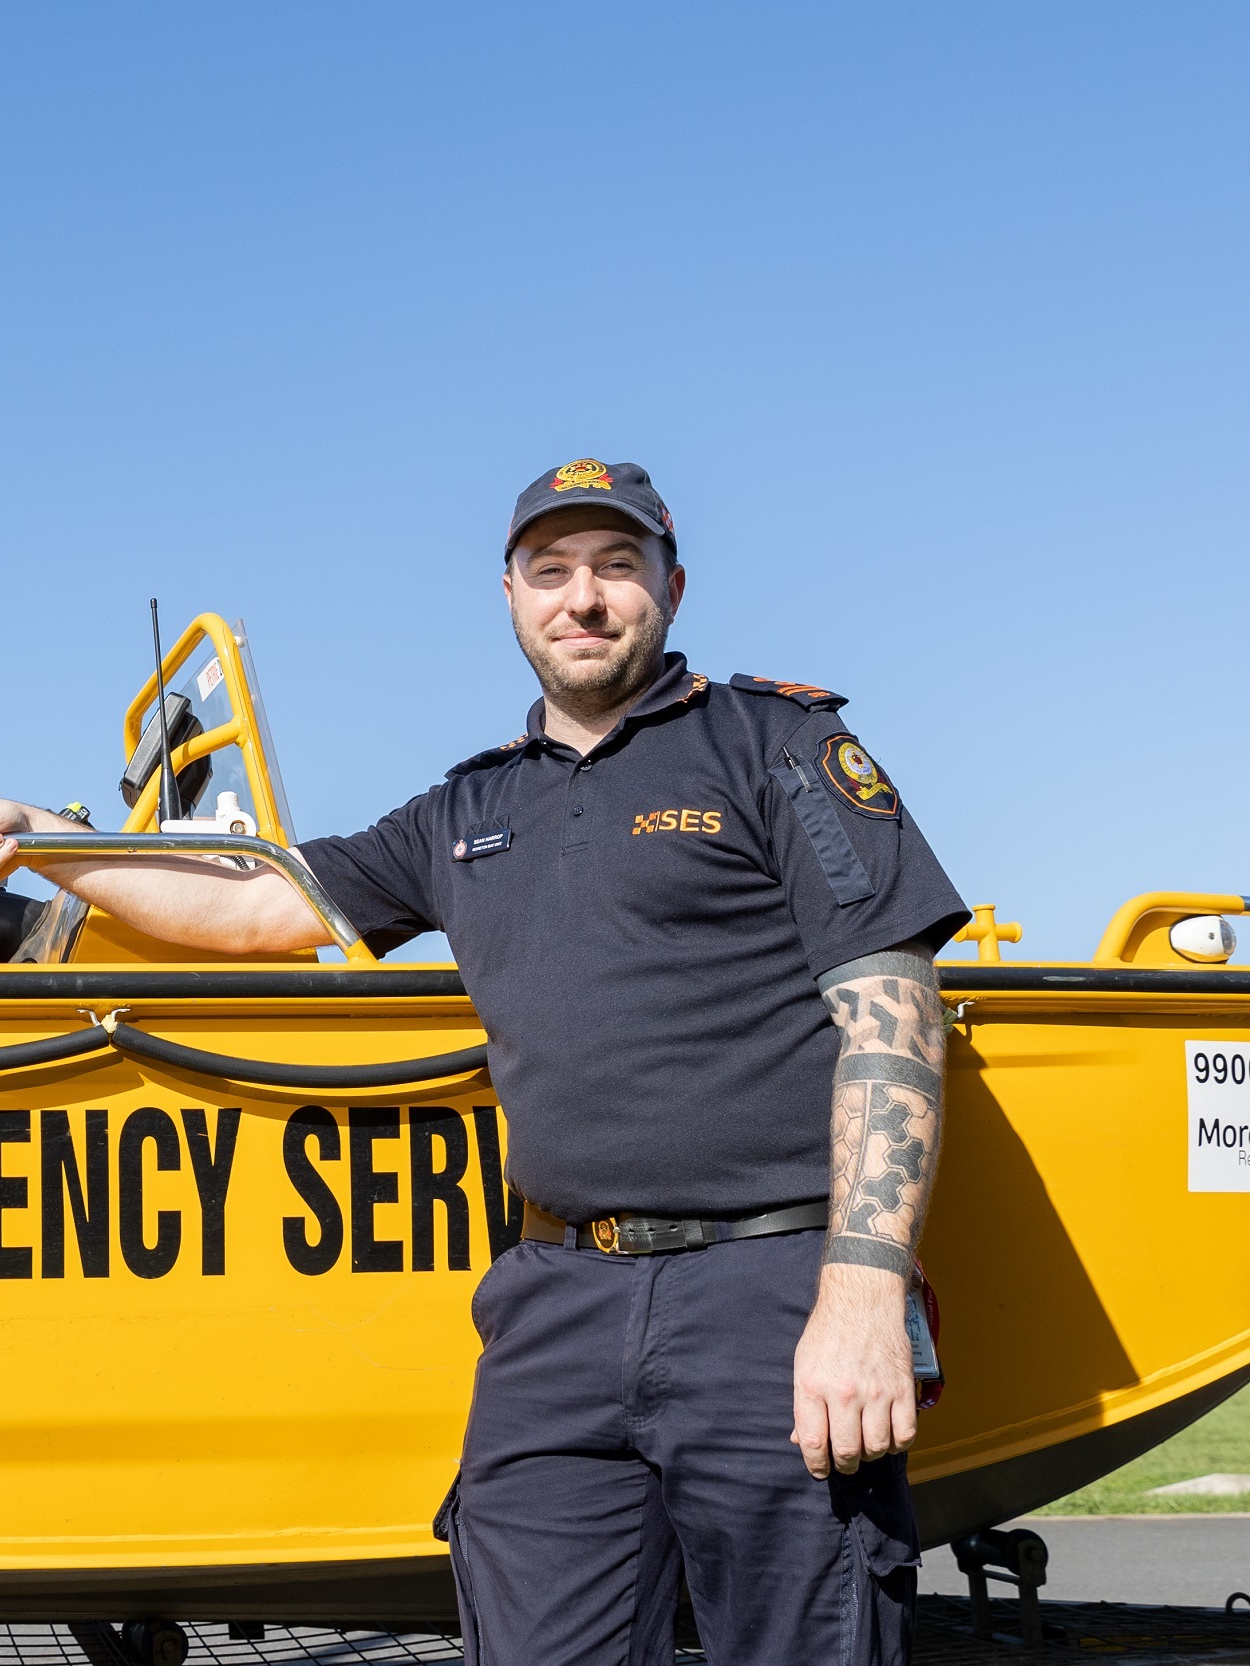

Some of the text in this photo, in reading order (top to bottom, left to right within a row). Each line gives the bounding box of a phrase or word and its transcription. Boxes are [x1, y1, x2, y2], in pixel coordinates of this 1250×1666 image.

[658, 808, 722, 834] SES
[1194, 1052, 1250, 1085] 990
[1198, 1117, 1250, 1148] Mor
